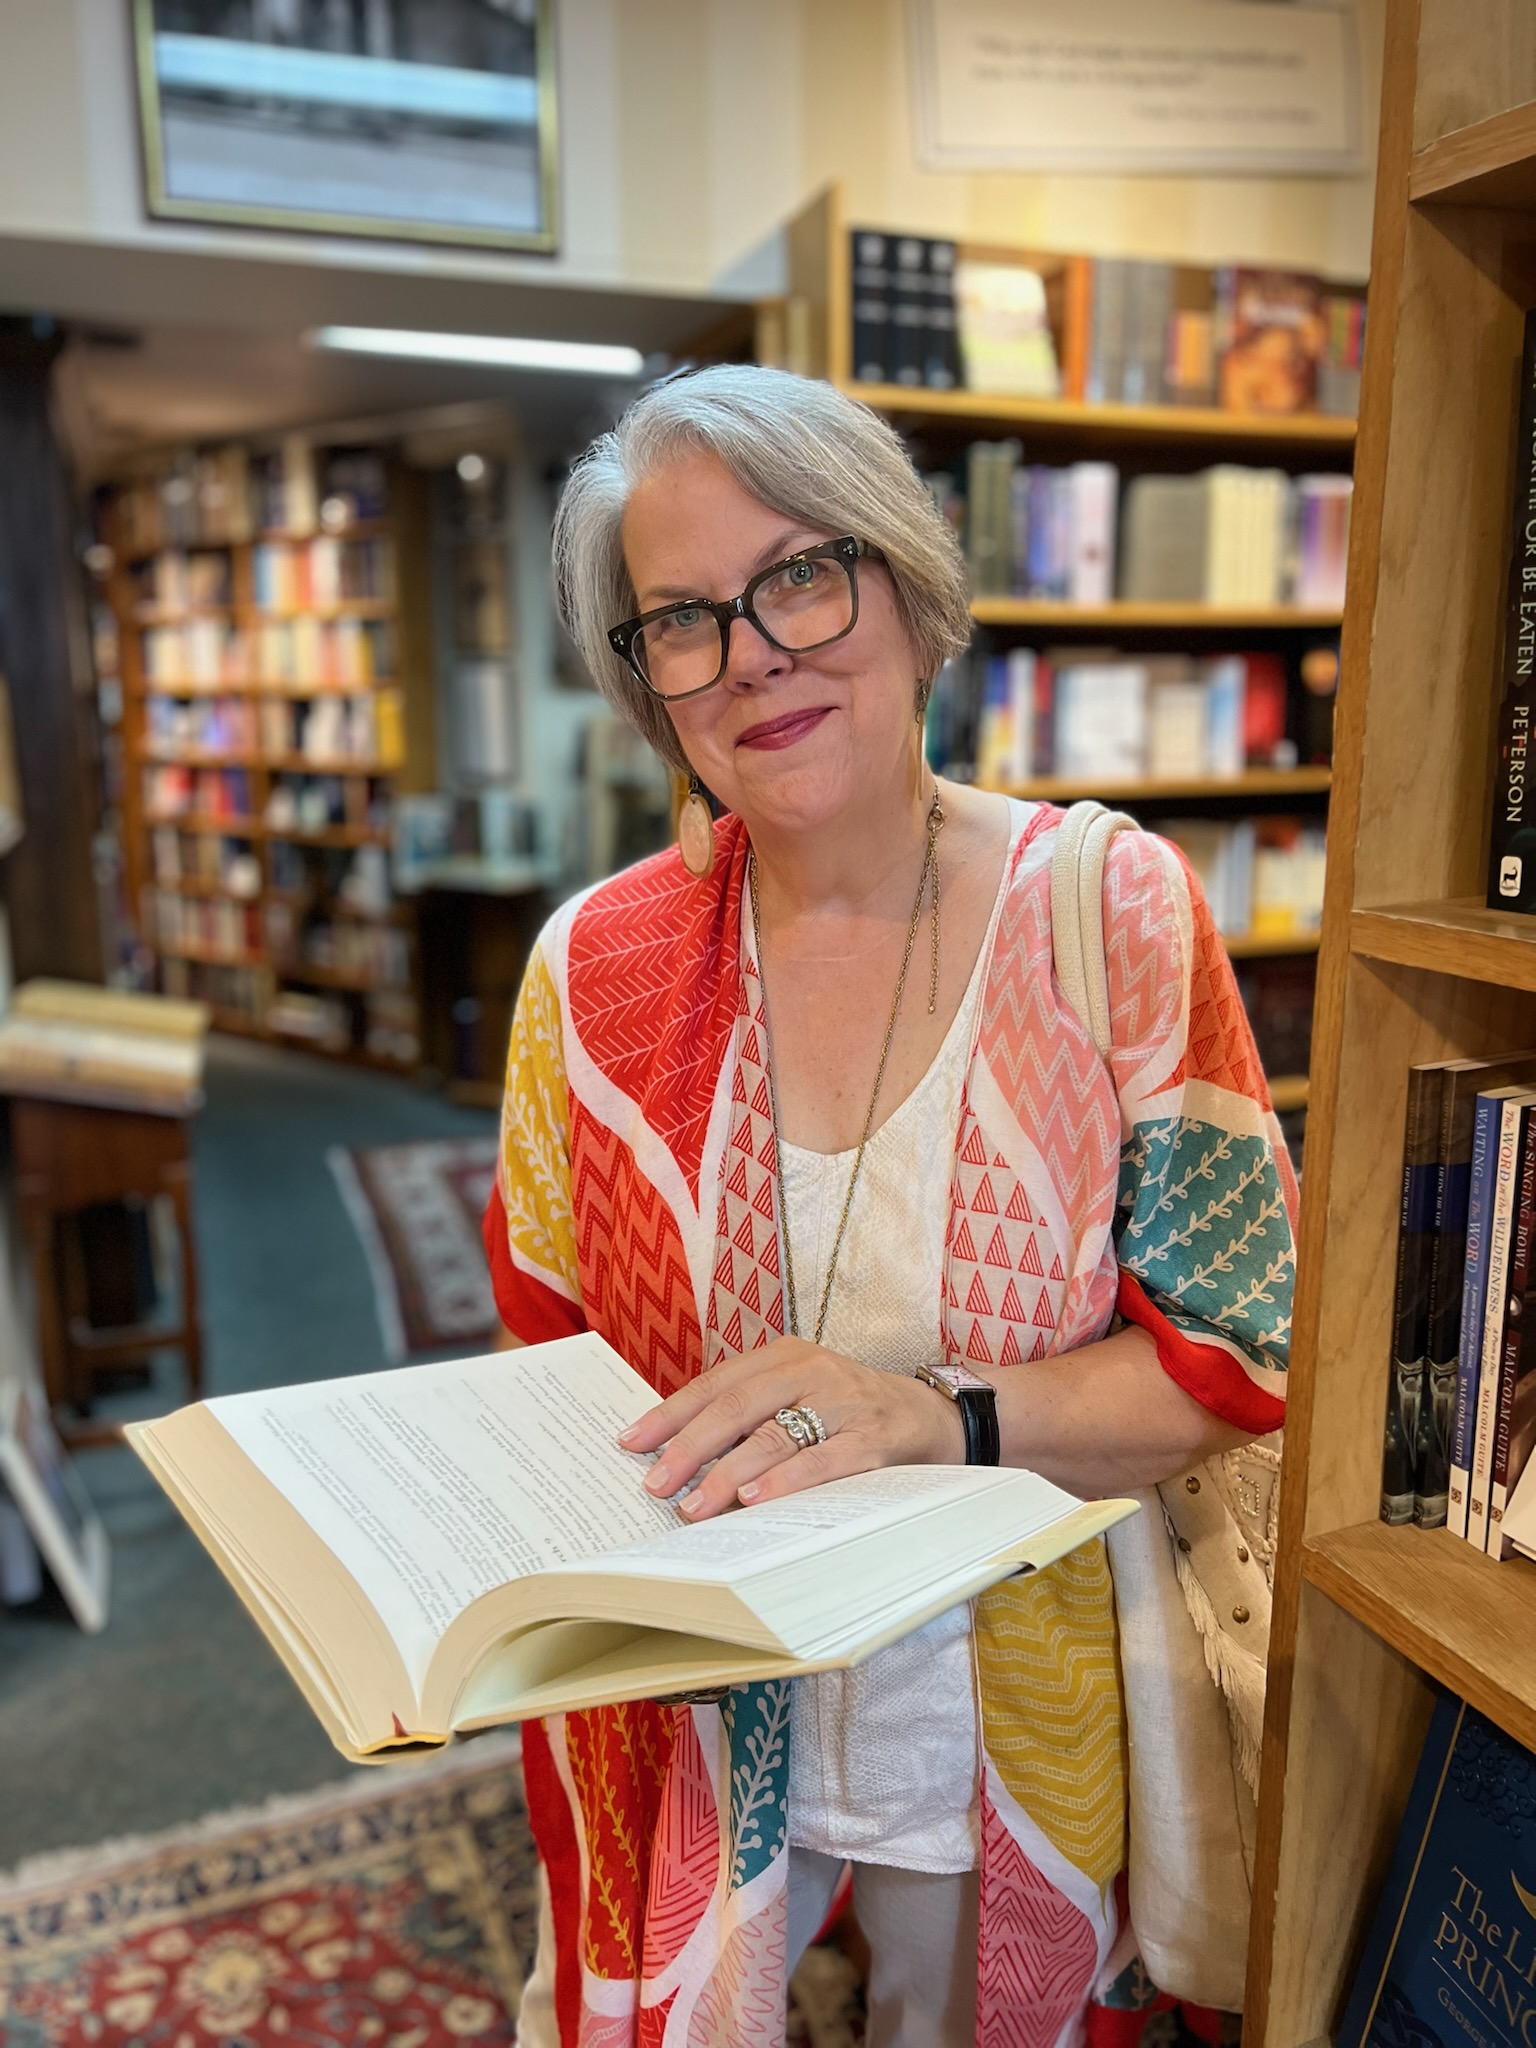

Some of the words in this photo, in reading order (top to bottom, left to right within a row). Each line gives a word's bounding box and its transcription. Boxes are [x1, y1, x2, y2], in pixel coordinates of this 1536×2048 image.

[1522, 567, 1536, 593] BE
[1516, 602, 1536, 675] EATEN
[1506, 706, 1530, 823] PETERSON
[1473, 1107, 1489, 1178] WAITING
[1504, 1109, 1515, 1130] The
[1499, 1132, 1514, 1182] WORD
[1470, 1200, 1481, 1220] The
[1472, 1180, 1480, 1195] on
[1519, 1151, 1536, 1219] SINGING
[1466, 1222, 1481, 1274] WORD
[1489, 1216, 1507, 1314] WILDERNESS
[1513, 1225, 1528, 1271] BOWL
[1457, 1376, 1468, 1429] MALCOLM
[1498, 1342, 1517, 1421] MALCOLM
[1479, 1387, 1491, 1441] MALCOLM
[1454, 1430, 1464, 1465] GUITE
[1476, 1442, 1487, 1476] GUITE
[1495, 1423, 1509, 1472] GUITE
[1451, 1865, 1502, 1948] The
